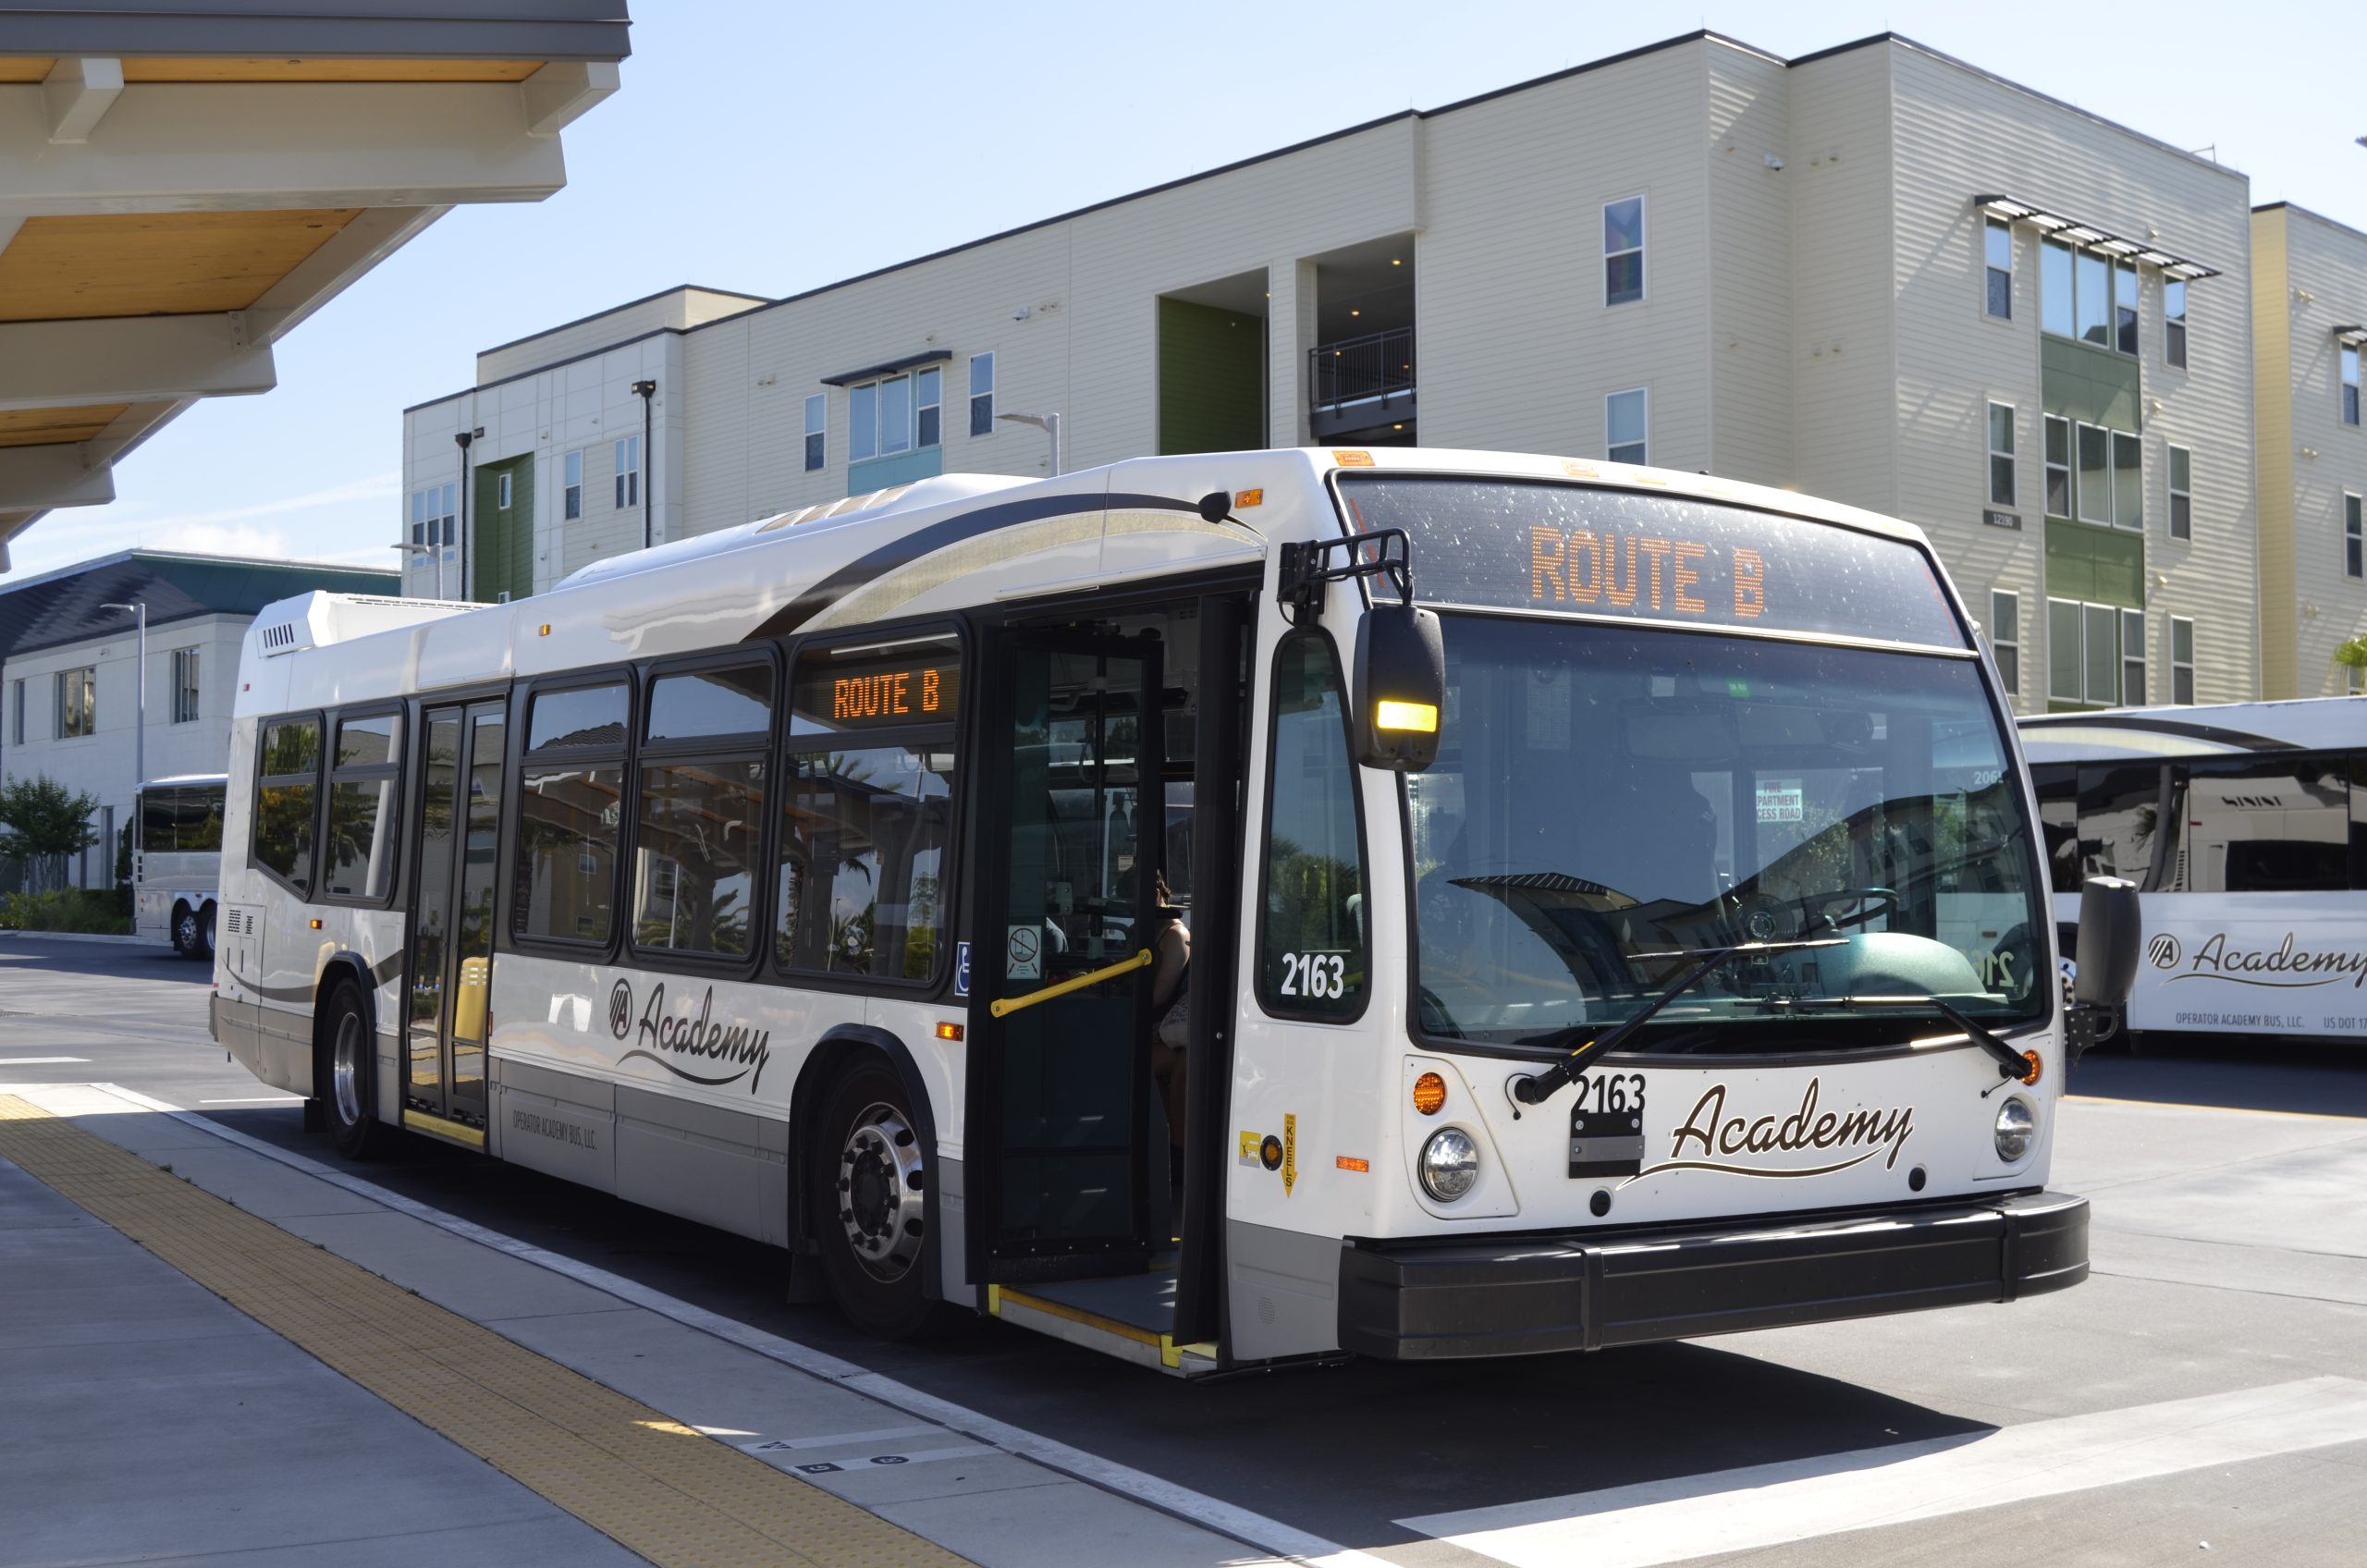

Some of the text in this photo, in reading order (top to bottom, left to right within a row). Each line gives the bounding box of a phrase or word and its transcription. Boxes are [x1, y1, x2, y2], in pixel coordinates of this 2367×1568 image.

[1531, 525, 1764, 619] ROUTE B
[834, 668, 939, 718] ROUTE B
[1756, 794, 1799, 807] PARTMENT
[1763, 781, 1782, 793] FIRE
[1757, 807, 1801, 821] CESS ROAD
[1281, 952, 1344, 999] 2163
[2192, 931, 2367, 988] Academy
[637, 982, 770, 1095] Academy
[2176, 1012, 2305, 1029] OPERATOR ACADEMY BUS, LLC.
[2324, 1017, 2336, 1029] US
[2338, 1017, 2356, 1030] DOT
[1571, 1073, 1646, 1113] 2163
[513, 1109, 541, 1135] OPERATOR
[542, 1117, 569, 1143] ACADEMY
[569, 1124, 583, 1149] BUS,
[1668, 1076, 1915, 1171] Academy
